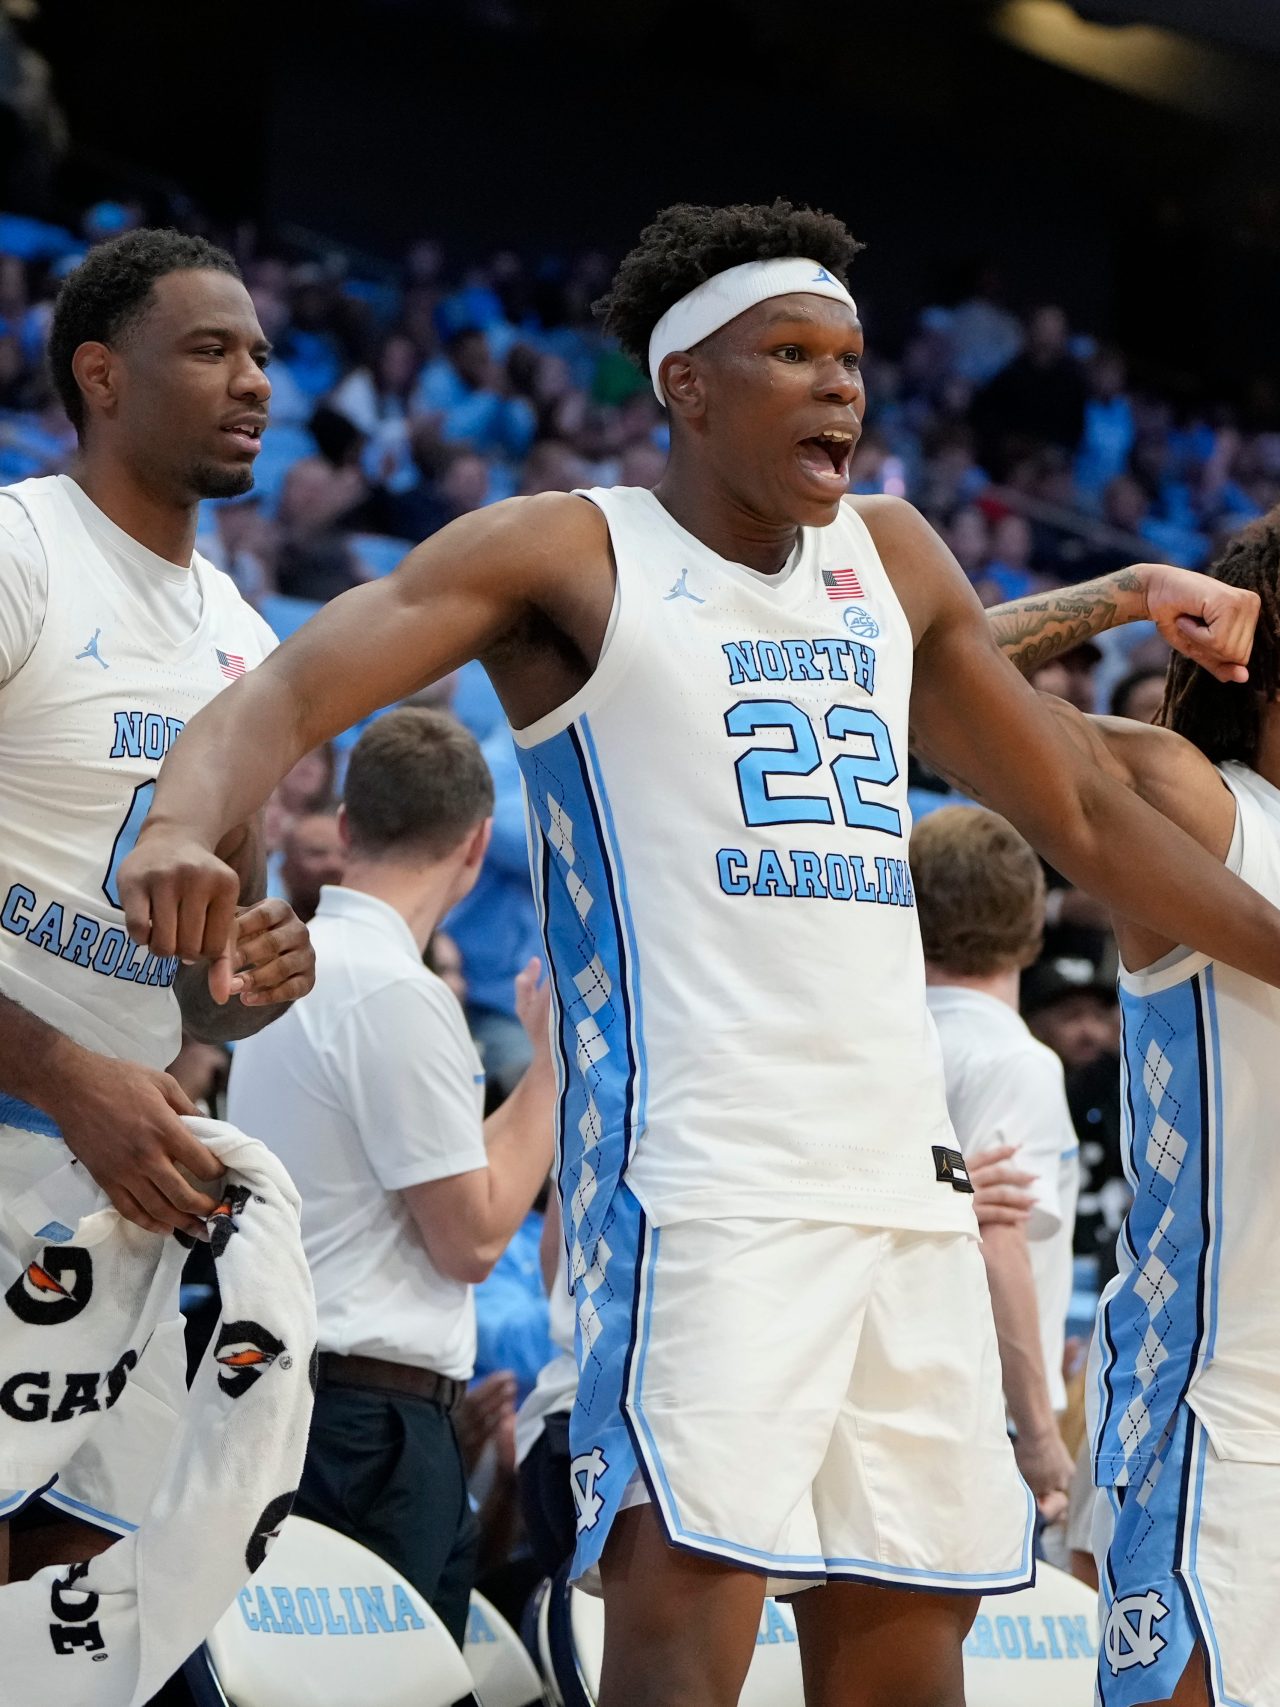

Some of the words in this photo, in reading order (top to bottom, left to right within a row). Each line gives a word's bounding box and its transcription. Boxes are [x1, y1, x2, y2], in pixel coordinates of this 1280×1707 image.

[722, 638, 876, 696] NORTH
[723, 699, 902, 838] 22
[716, 848, 914, 907] CAROLINA
[238, 1584, 425, 1635] CAROLINA
